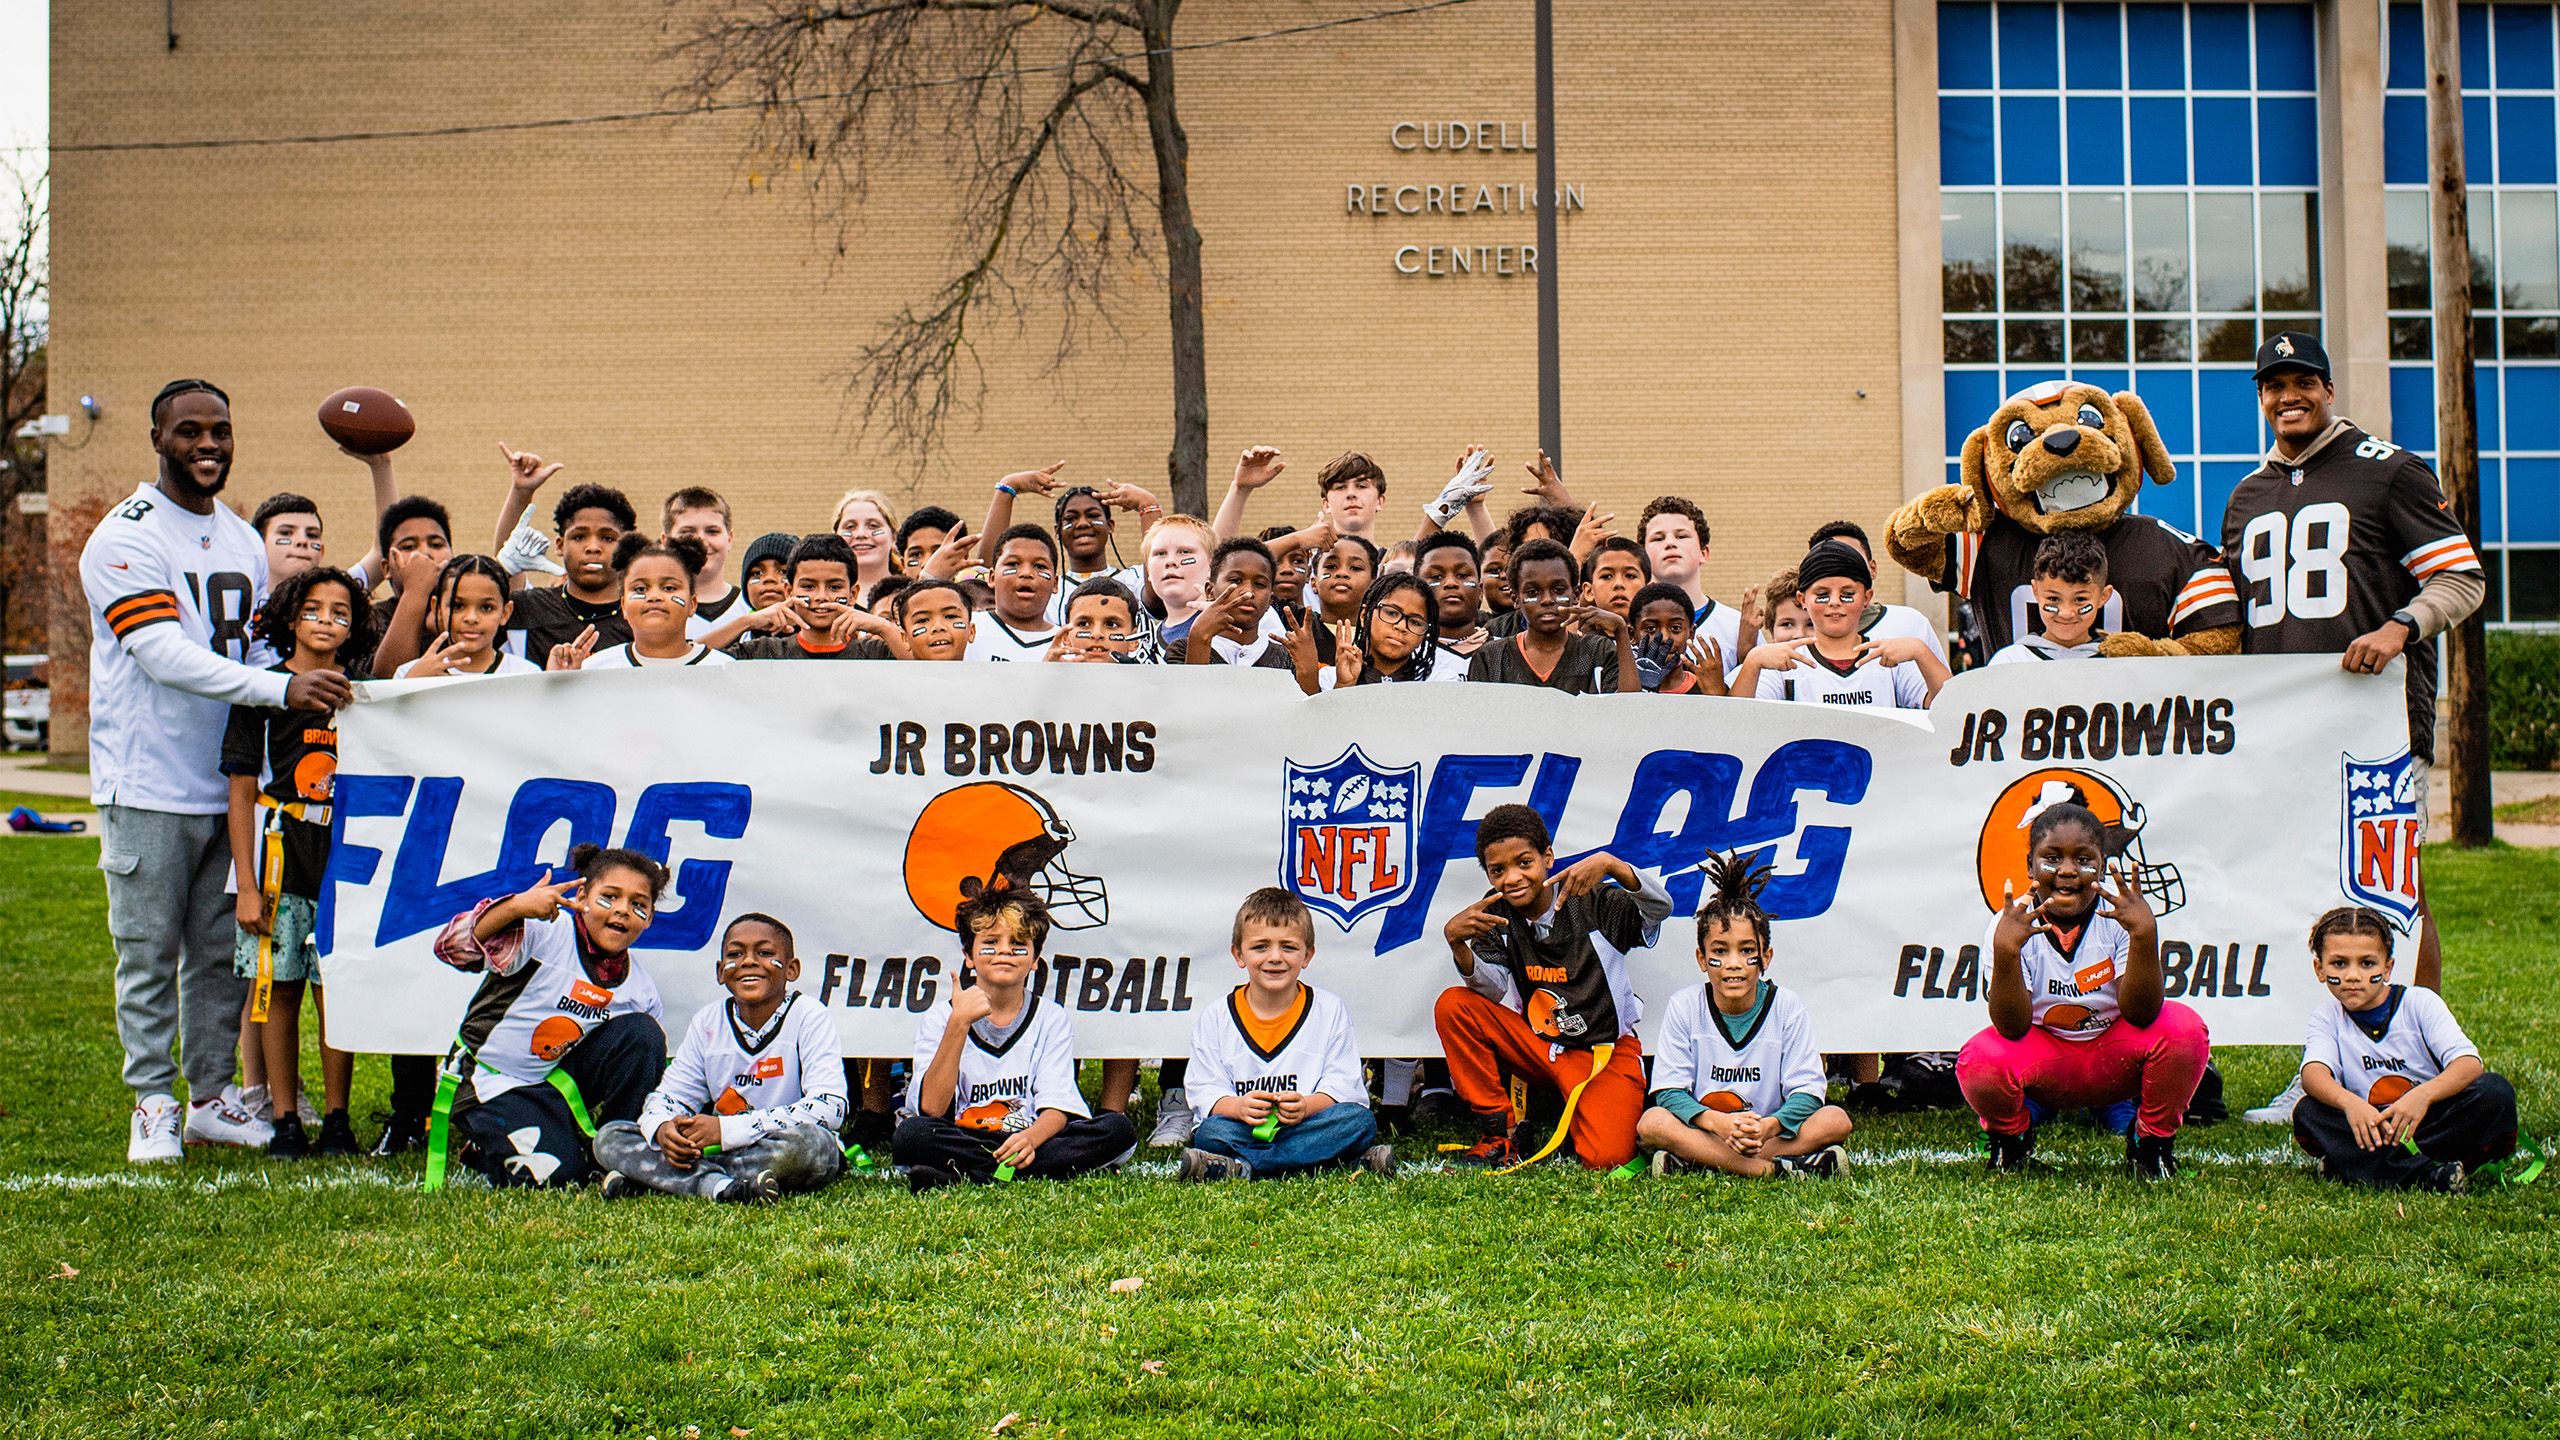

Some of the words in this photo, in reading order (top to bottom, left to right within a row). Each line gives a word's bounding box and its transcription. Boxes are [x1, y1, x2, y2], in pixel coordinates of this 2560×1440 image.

[1391, 121, 1537, 150] CUDELL
[1394, 245, 1539, 275] CENTER
[2241, 501, 2350, 629] 98
[1822, 690, 1873, 706] BROWNS
[870, 721, 927, 777] JR
[945, 720, 1157, 777] BROWNS
[1950, 708, 2008, 767] JR
[2020, 695, 2236, 761] BROWNS
[314, 773, 752, 959] FLAG
[1297, 826, 1400, 901] NFL
[1373, 738, 1873, 957] FLAG
[819, 953, 942, 1014] FLAG
[1893, 944, 1990, 1003] FLA
[556, 995, 612, 1021] BROWNS
[1711, 1064, 1761, 1083] BROWNS
